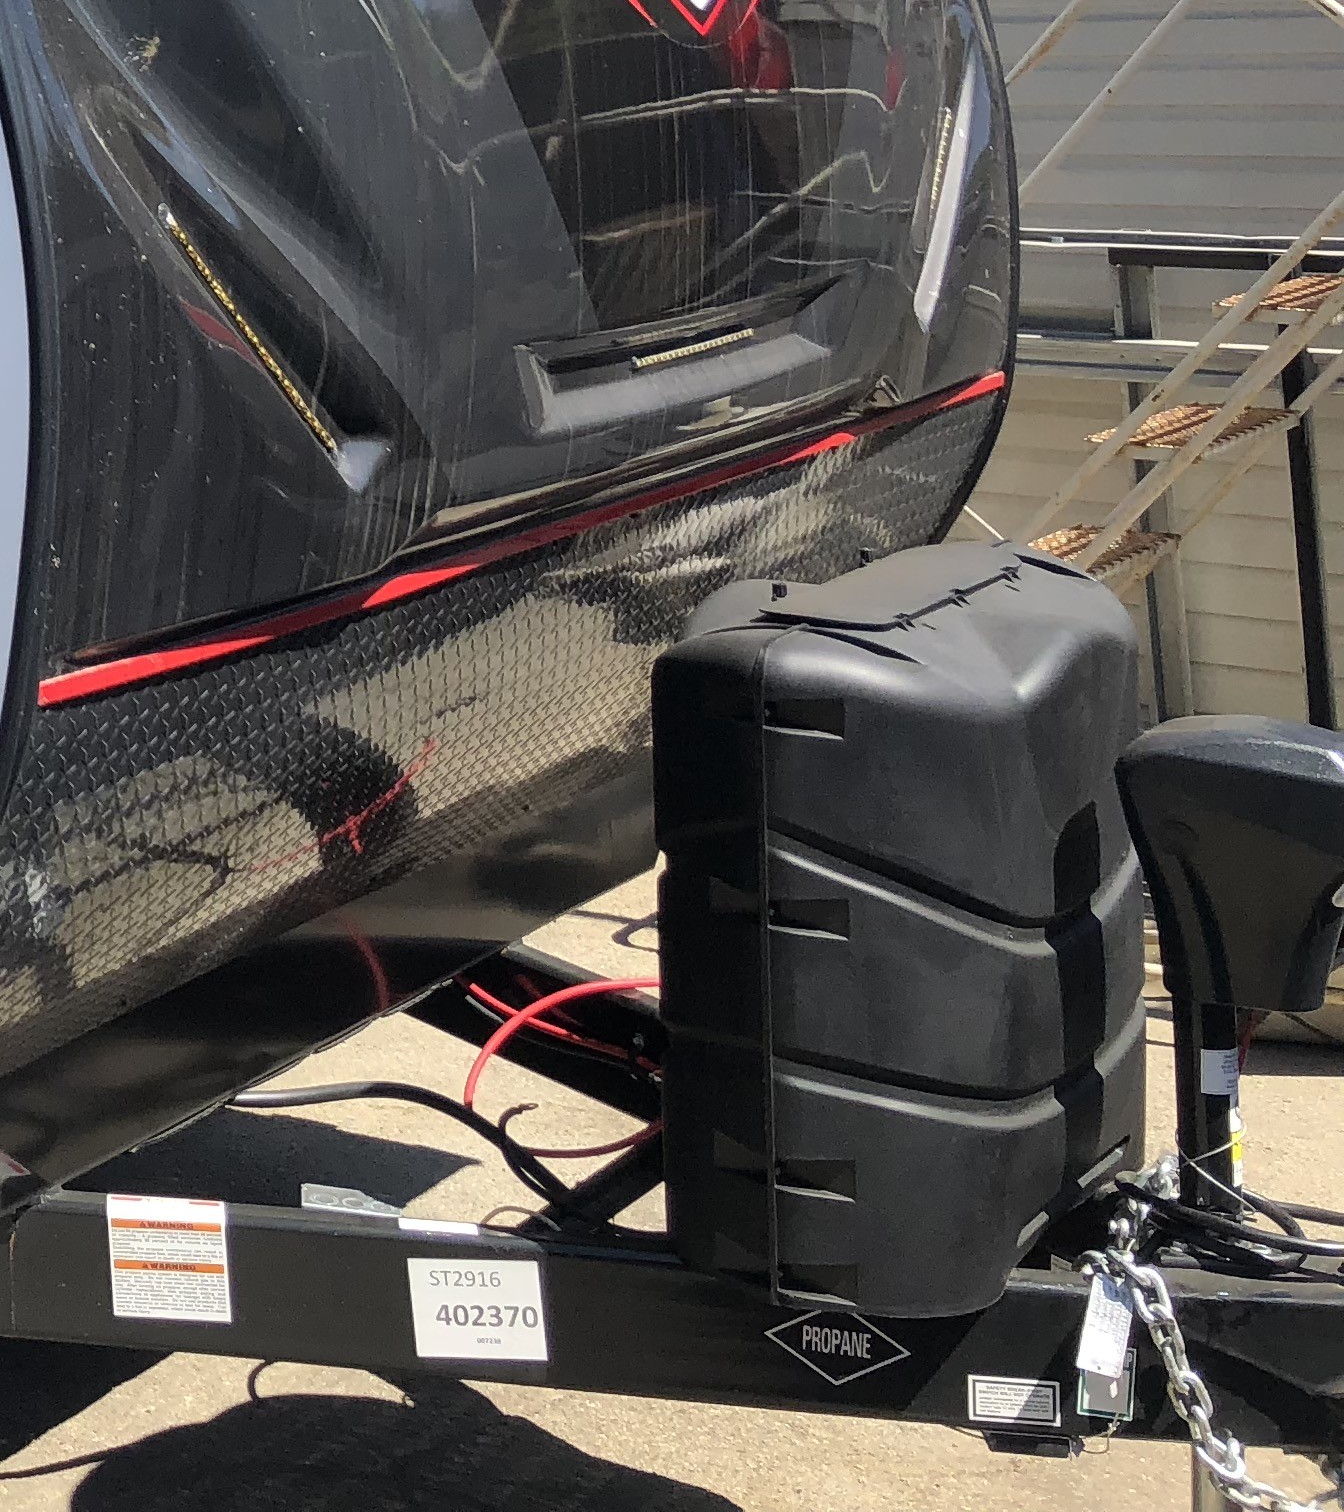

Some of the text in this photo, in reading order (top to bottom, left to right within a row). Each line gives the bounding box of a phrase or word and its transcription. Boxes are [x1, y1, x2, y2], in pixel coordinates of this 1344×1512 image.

[147, 1220, 194, 1230] WARNING
[150, 1262, 196, 1271] WARNING
[429, 1269, 502, 1288] ST2916
[435, 1304, 539, 1329] 402370
[802, 1324, 872, 1360] PROPANE
